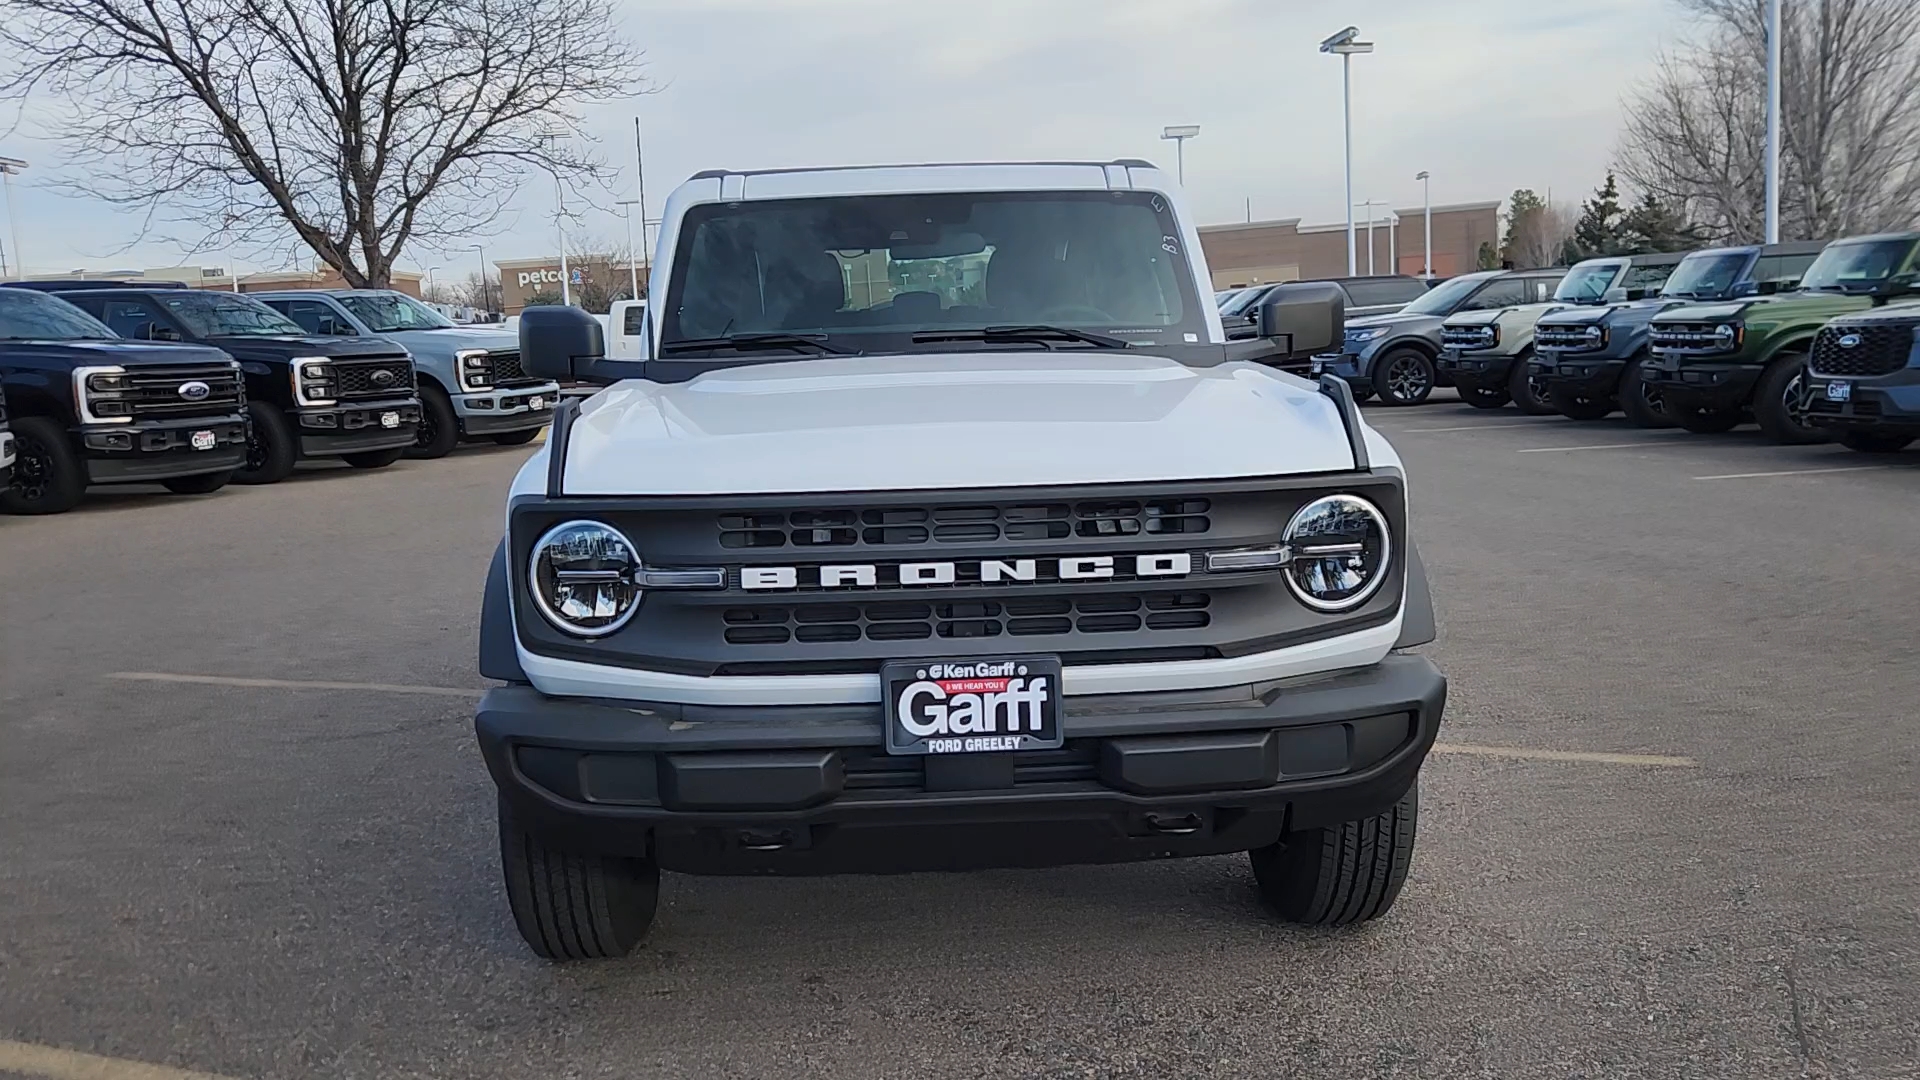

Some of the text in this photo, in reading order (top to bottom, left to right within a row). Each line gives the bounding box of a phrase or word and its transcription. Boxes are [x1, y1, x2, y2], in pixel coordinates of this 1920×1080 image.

[518, 268, 570, 288] petco
[740, 553, 1191, 590] BRONCO
[943, 664, 975, 678] Ken
[975, 661, 1015, 677] Garff
[951, 680, 999, 691] WE HEAR YOU
[898, 677, 1048, 737] Garff
[928, 736, 1021, 753] FORD GREELEY
